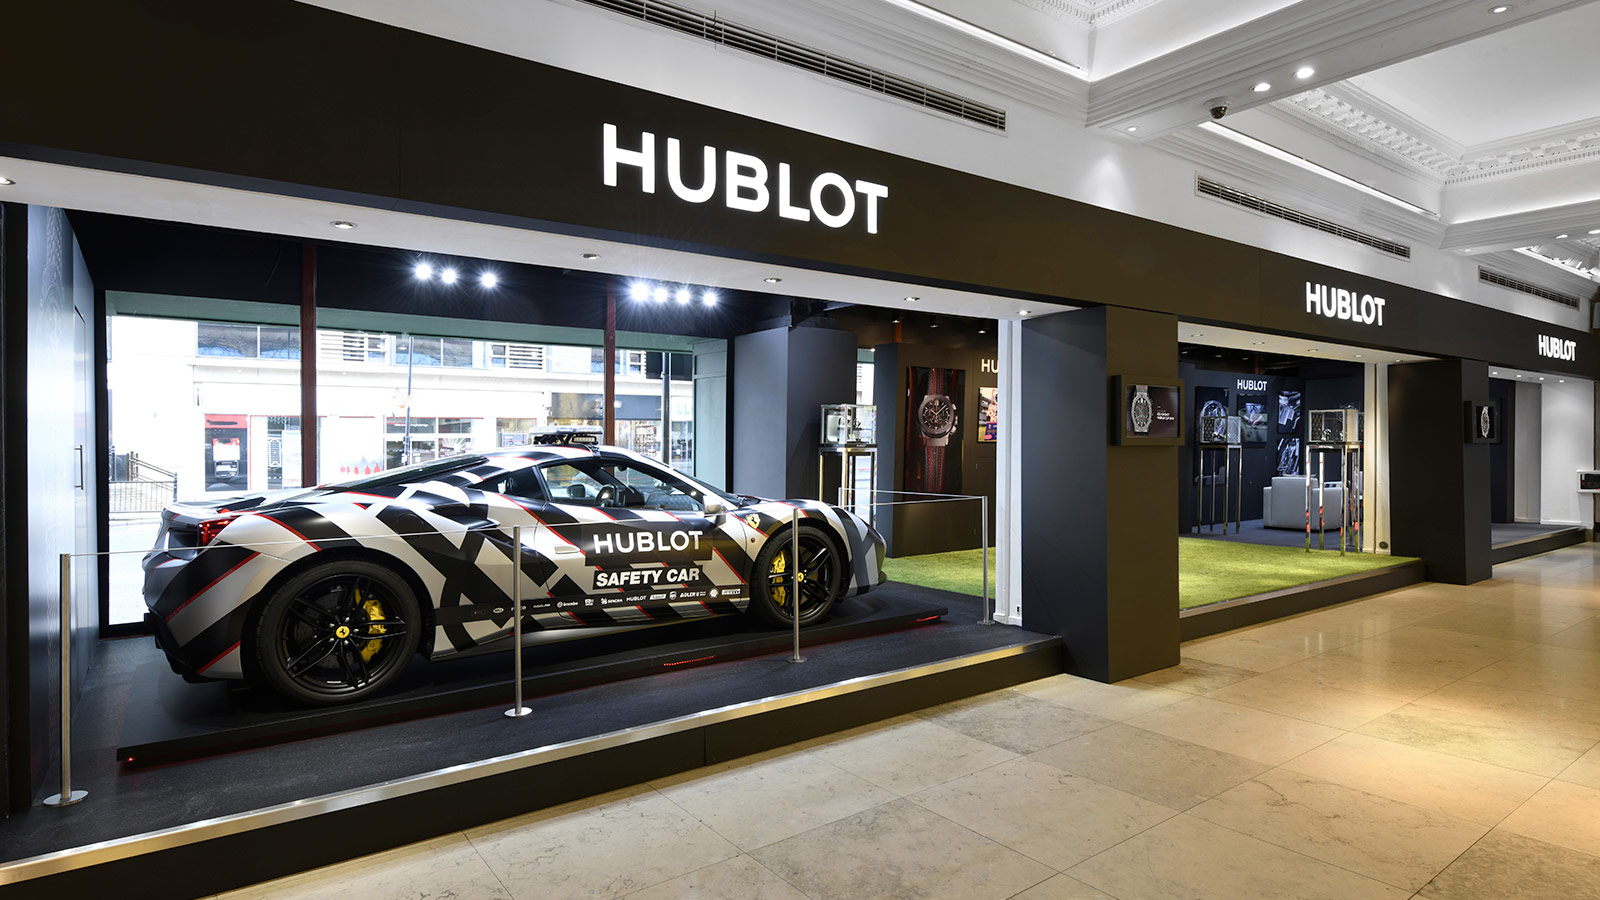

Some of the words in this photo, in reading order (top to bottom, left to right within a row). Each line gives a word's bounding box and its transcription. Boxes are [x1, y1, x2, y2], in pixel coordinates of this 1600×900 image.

[603, 122, 889, 235] HUBLOT
[1306, 281, 1386, 327] HUBLOT
[1538, 334, 1577, 362] HUBLOT
[1236, 379, 1268, 391] HUBLOT
[593, 530, 703, 554] HUBLOT
[596, 569, 662, 587] SAFETY
[666, 567, 700, 582] CAR
